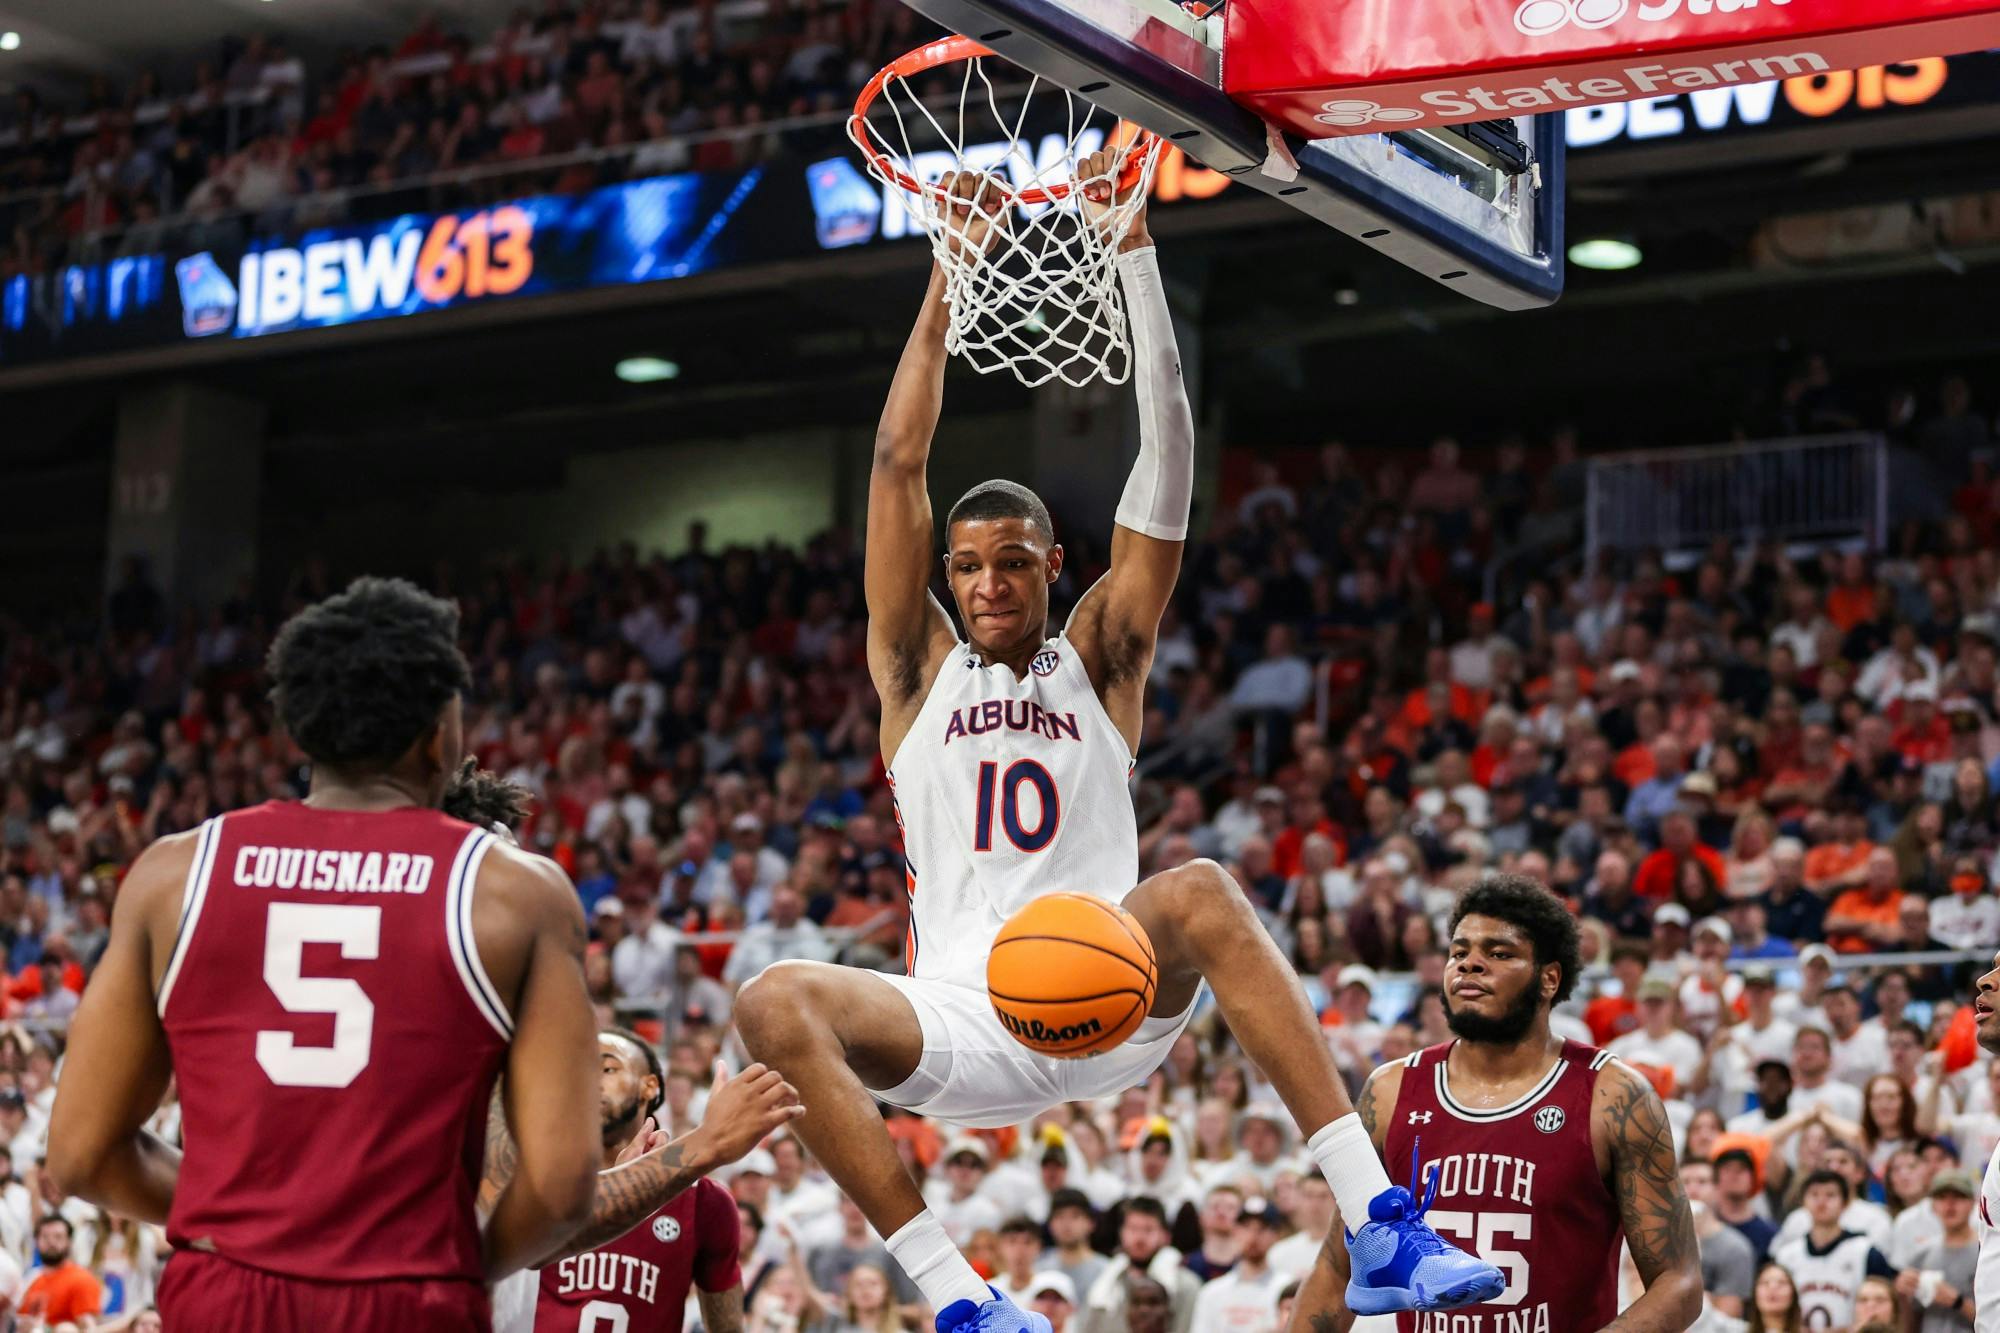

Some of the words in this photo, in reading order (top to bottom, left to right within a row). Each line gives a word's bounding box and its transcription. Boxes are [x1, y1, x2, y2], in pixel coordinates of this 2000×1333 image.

[1032, 651, 1058, 676] SEC
[945, 699, 1082, 746] AUBURN
[974, 758, 1061, 853] 10
[233, 845, 434, 894] COUISNARD
[255, 901, 382, 1088] 5
[994, 1003, 1102, 1042] Wilson
[1536, 1108, 1564, 1132] SEC
[558, 1252, 660, 1304] SOUTH
